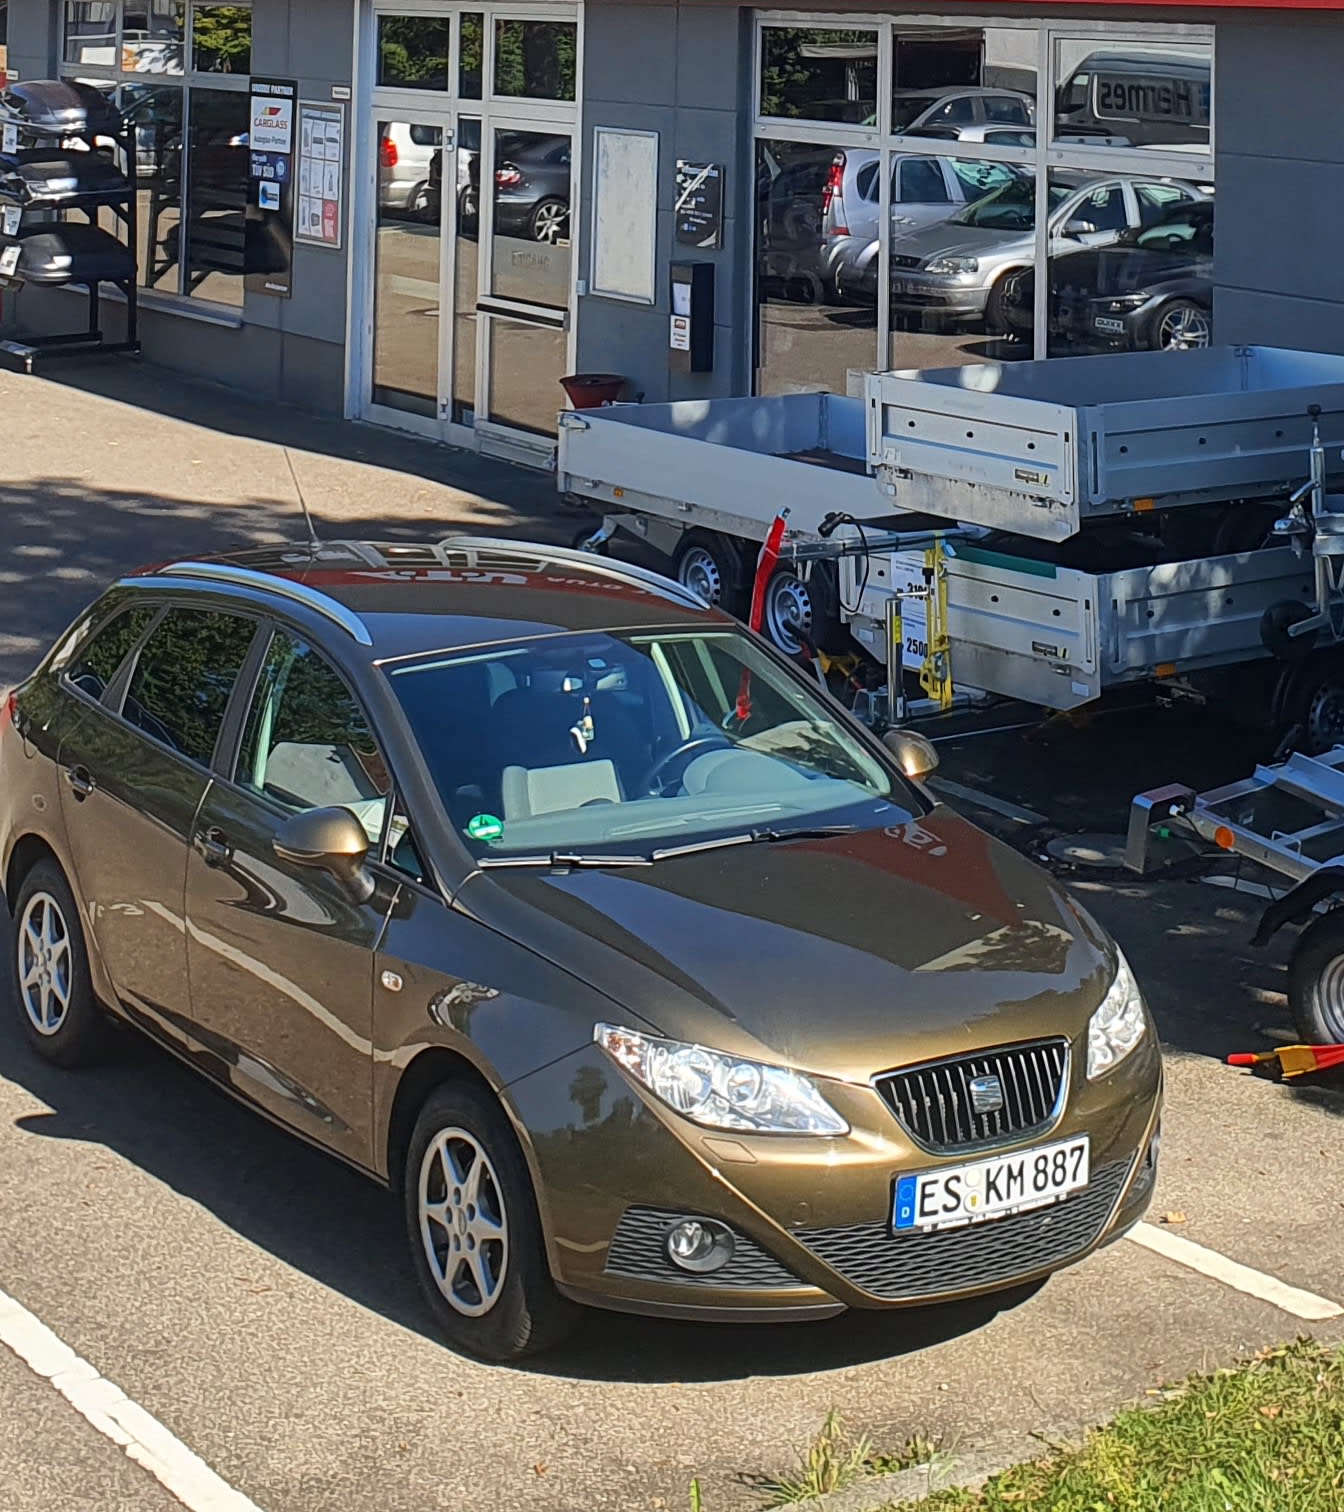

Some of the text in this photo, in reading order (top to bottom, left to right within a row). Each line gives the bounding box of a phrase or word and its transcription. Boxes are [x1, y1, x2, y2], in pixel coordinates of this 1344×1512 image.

[919, 1144, 1085, 1219] ES KM 887
[901, 1206, 910, 1218] D
